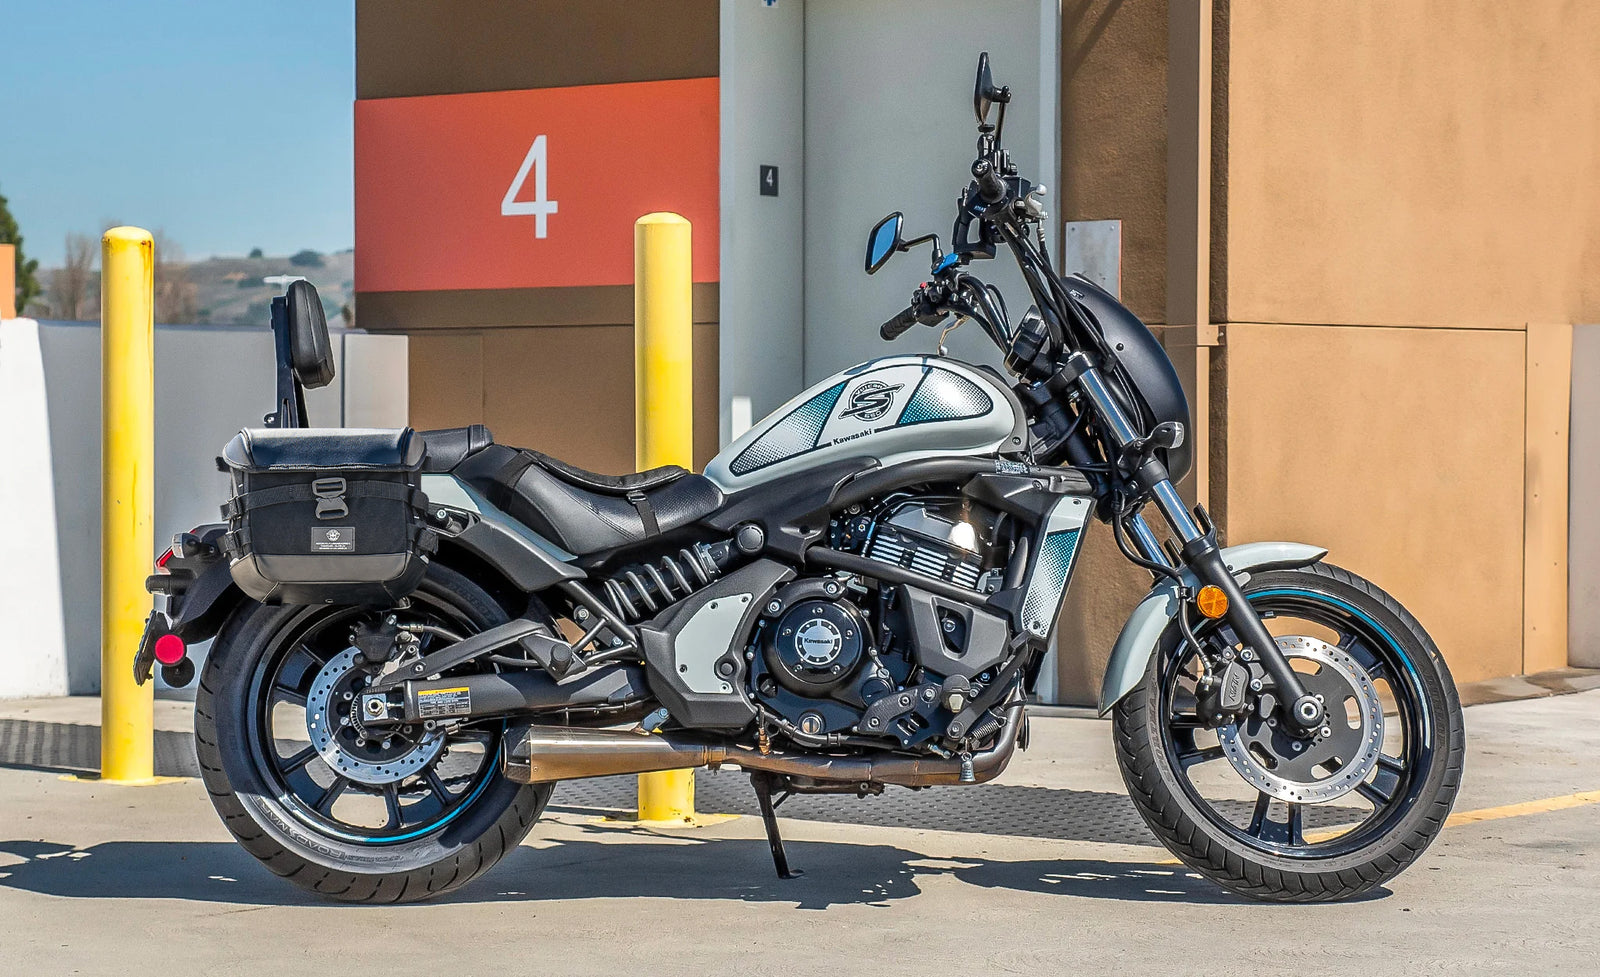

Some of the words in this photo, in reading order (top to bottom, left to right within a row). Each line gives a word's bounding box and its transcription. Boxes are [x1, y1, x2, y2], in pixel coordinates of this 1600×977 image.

[501, 134, 558, 239] 4
[766, 168, 773, 187] 4
[833, 428, 872, 445] Kawasaki
